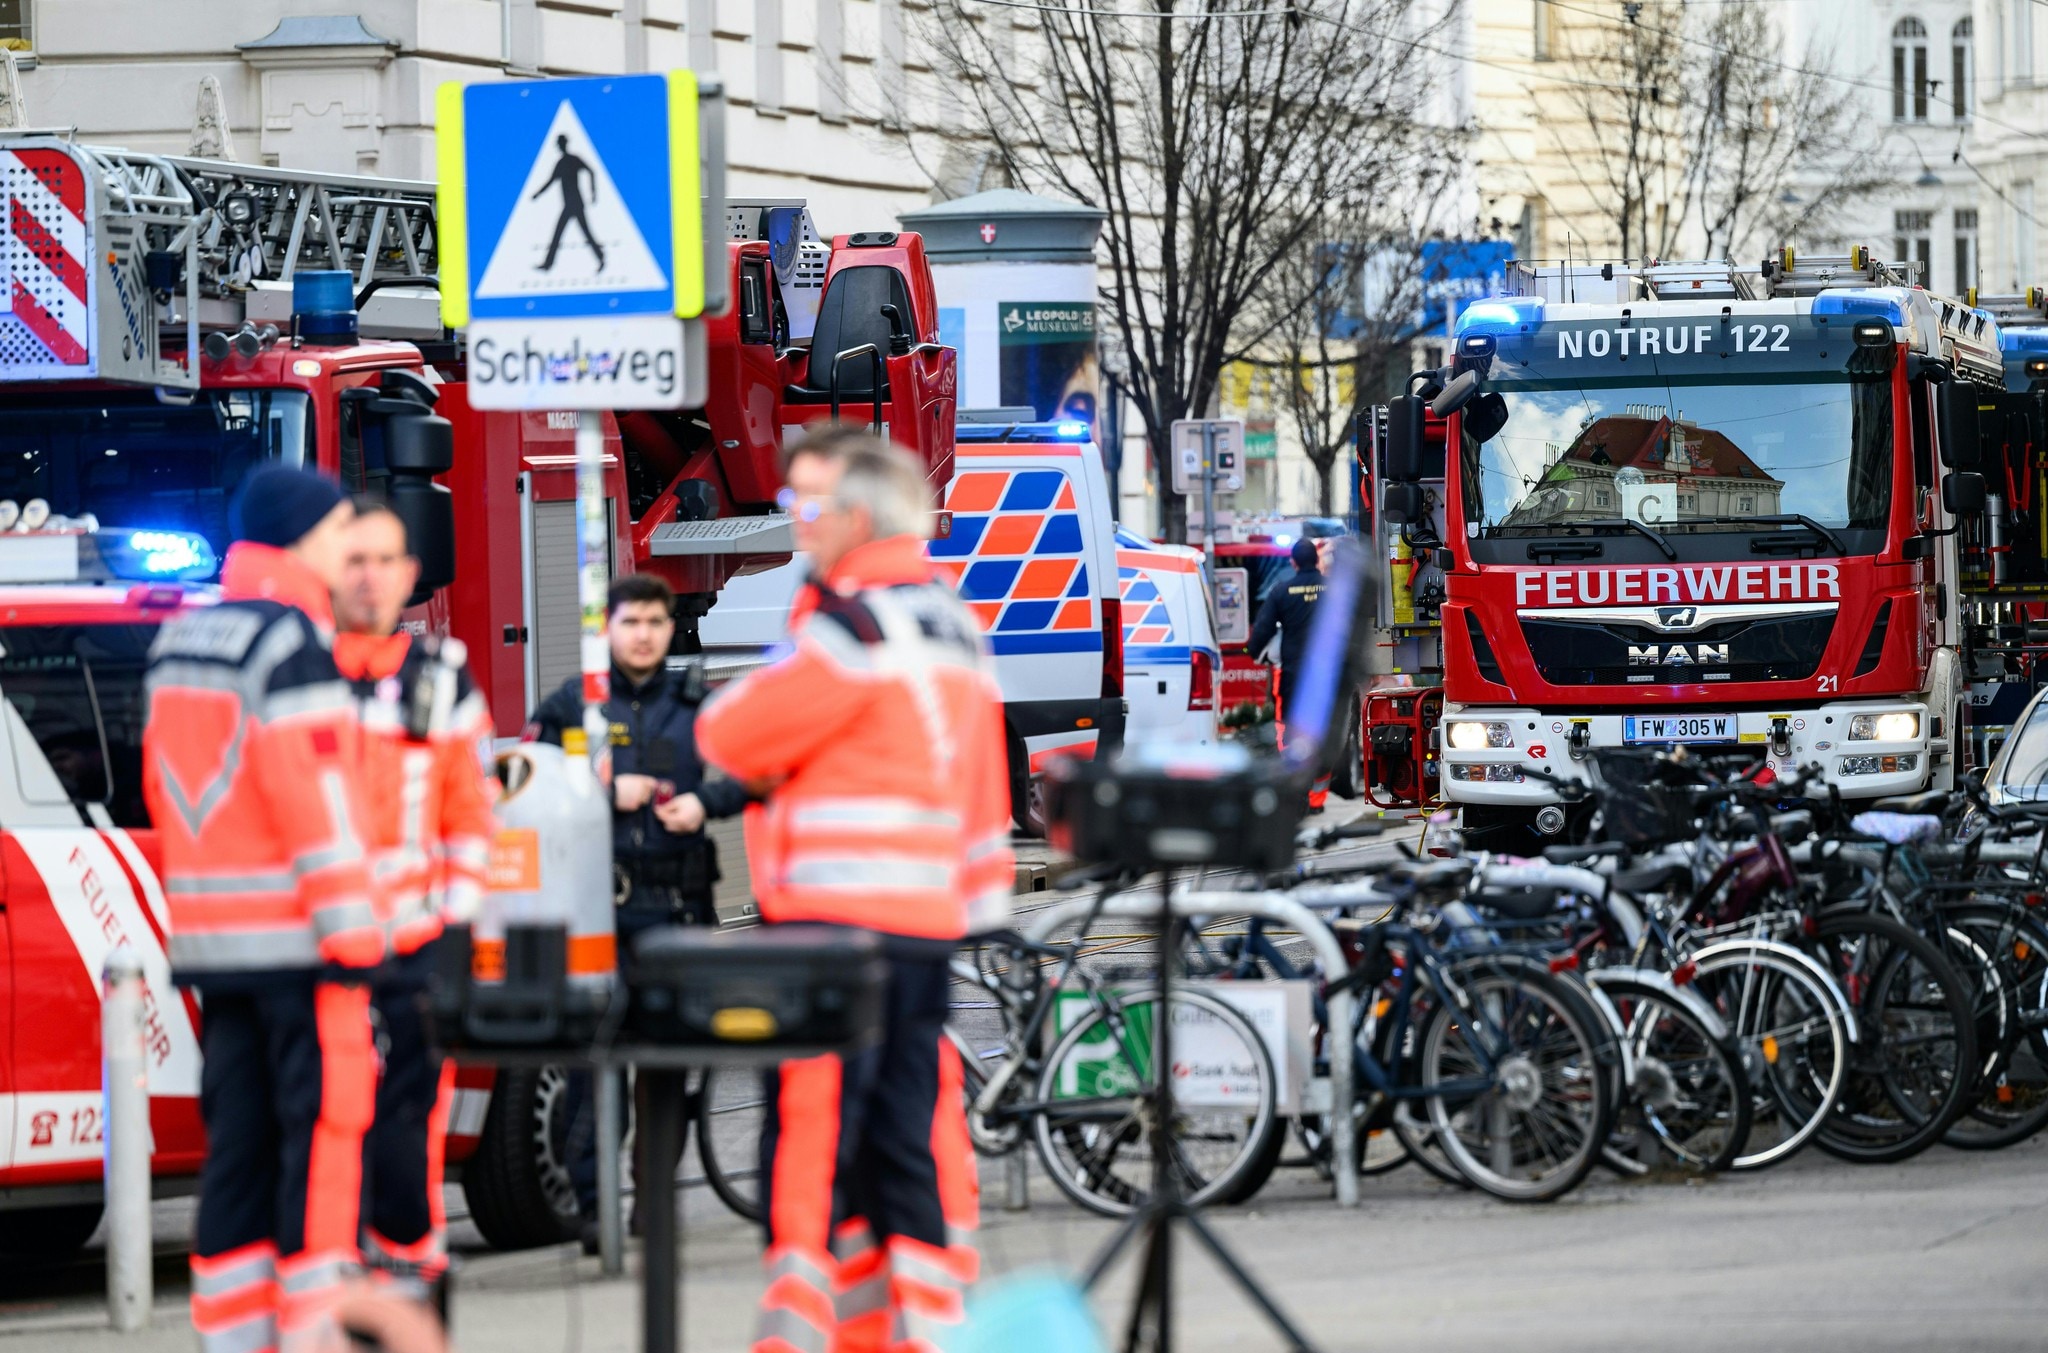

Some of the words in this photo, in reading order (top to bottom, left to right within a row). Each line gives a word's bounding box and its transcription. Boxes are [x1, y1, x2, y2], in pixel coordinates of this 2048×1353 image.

[109, 264, 145, 360] MAGIRUS
[1026, 310, 1078, 321] LEOPOLD
[1026, 321, 1079, 332] MUSEUM
[1558, 325, 1712, 359] NOTRUF
[1730, 324, 1790, 353] 122
[547, 411, 580, 430] MAGIRU
[1637, 494, 1663, 524] C
[1515, 564, 1842, 605] FEUERWEHR
[1628, 643, 1729, 666] MAN
[1816, 675, 1839, 693] 21
[1641, 720, 1665, 737] FW
[1678, 719, 1710, 736] 305
[1714, 719, 1726, 735] W
